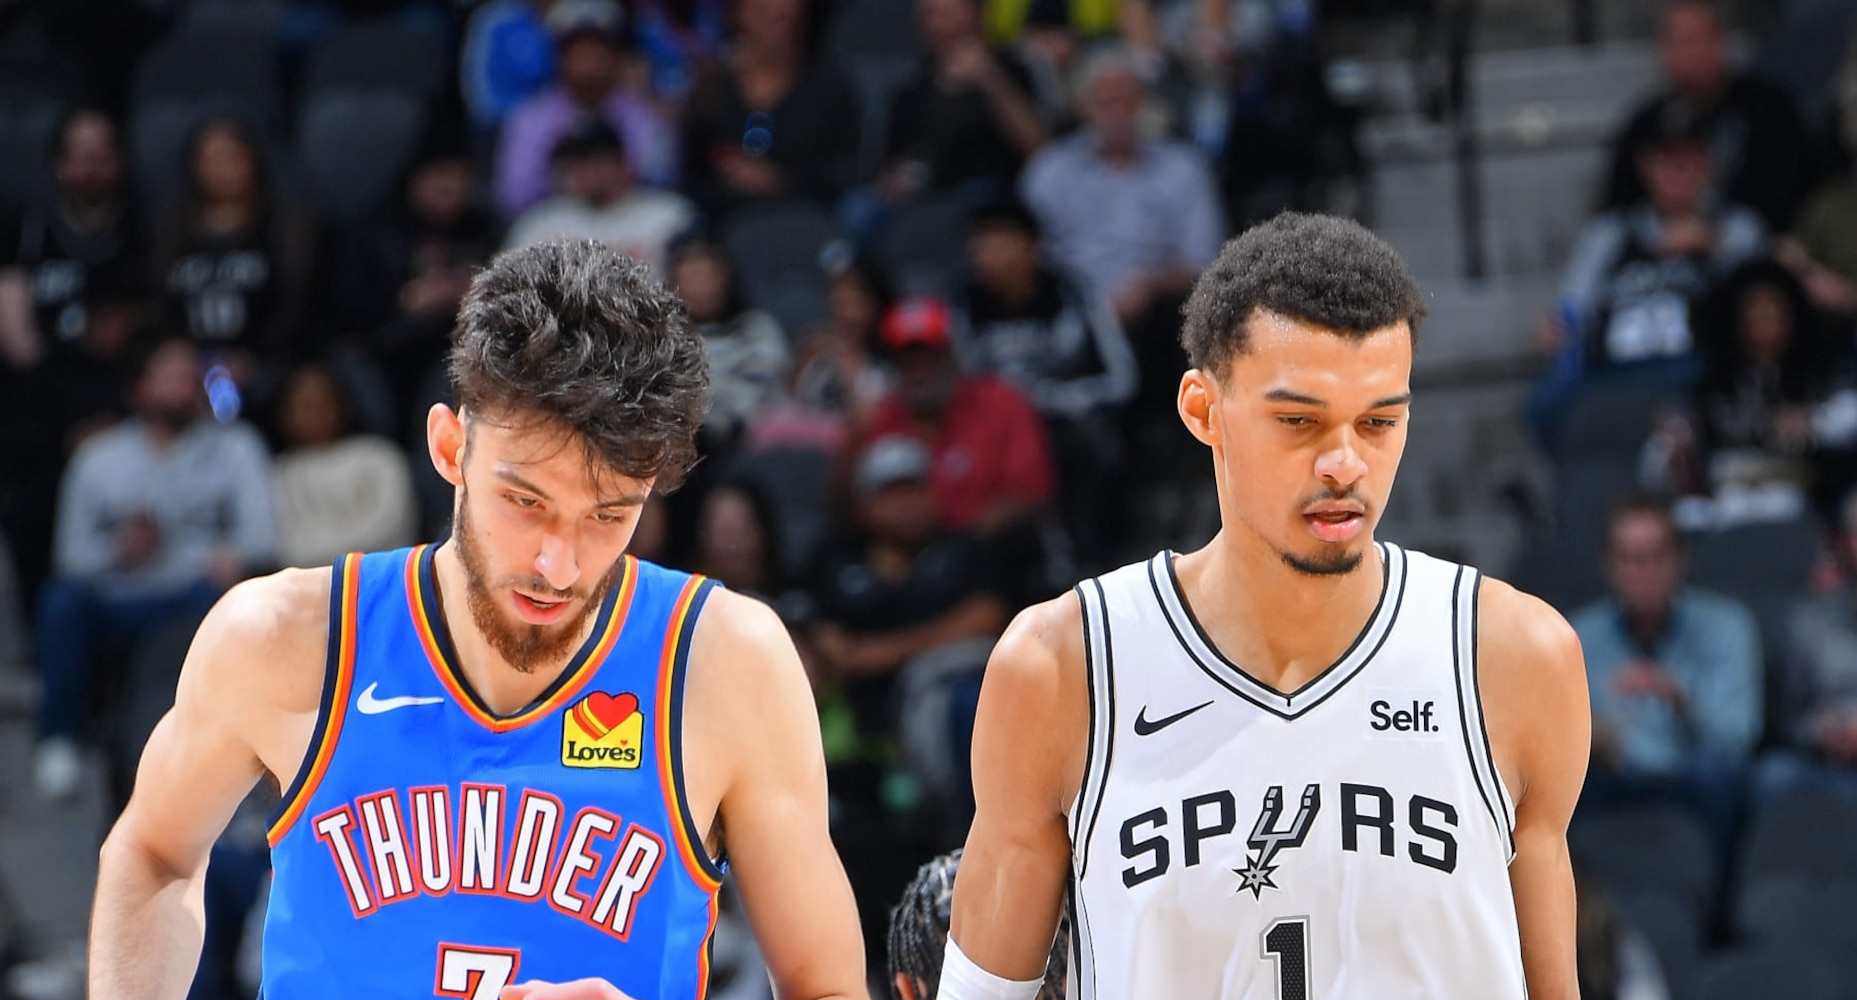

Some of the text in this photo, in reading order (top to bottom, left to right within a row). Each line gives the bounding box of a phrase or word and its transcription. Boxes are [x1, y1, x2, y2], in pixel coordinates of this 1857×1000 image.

[1370, 700, 1440, 733] Self.
[312, 782, 666, 942] THUNDER
[1119, 782, 1459, 902] SPURS
